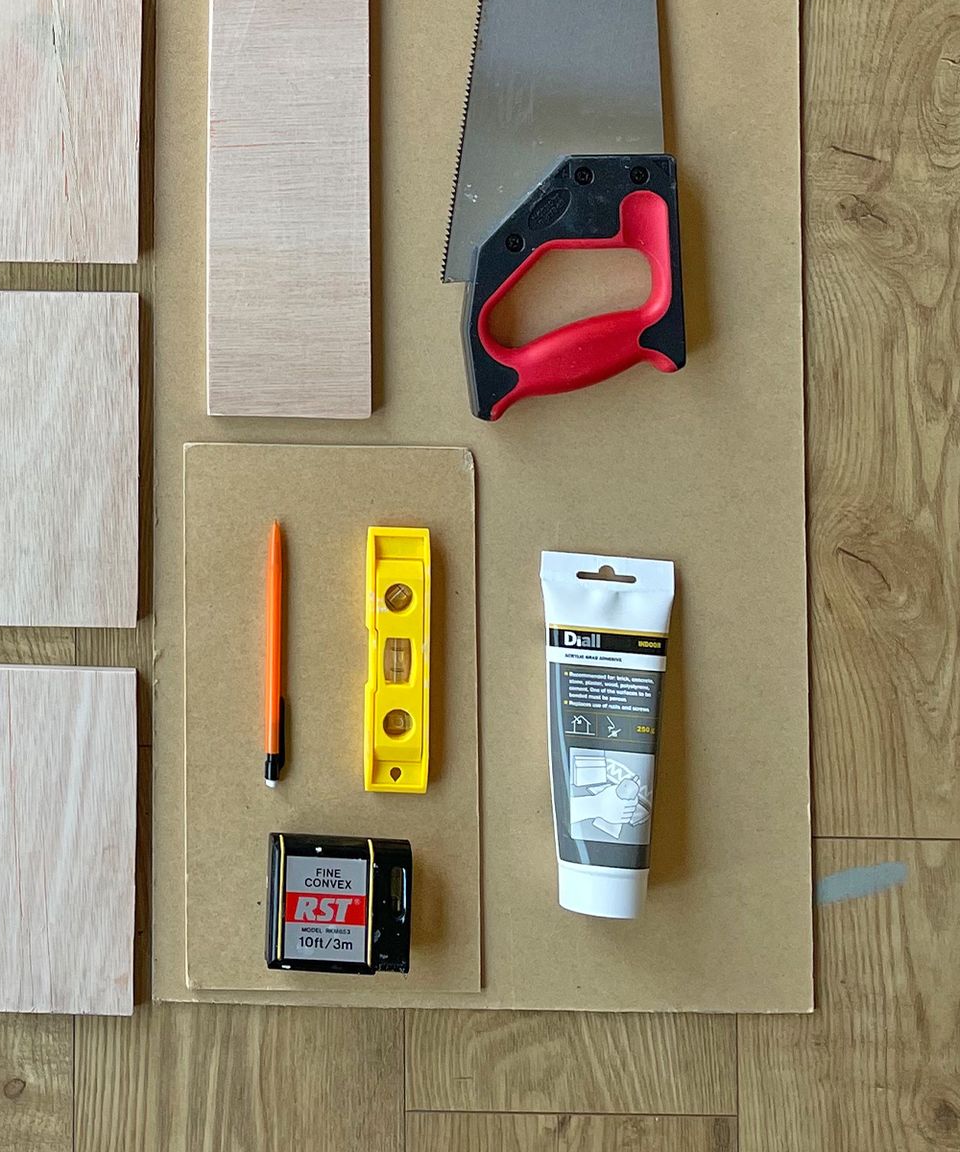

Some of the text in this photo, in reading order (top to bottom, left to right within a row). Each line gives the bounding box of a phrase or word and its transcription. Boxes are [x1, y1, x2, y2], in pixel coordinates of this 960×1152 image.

[564, 631, 601, 648] Diall
[315, 868, 341, 879] FINE
[304, 878, 352, 890] CONVEX
[301, 927, 323, 935] MODEL
[299, 936, 353, 950] 10ft/3m
